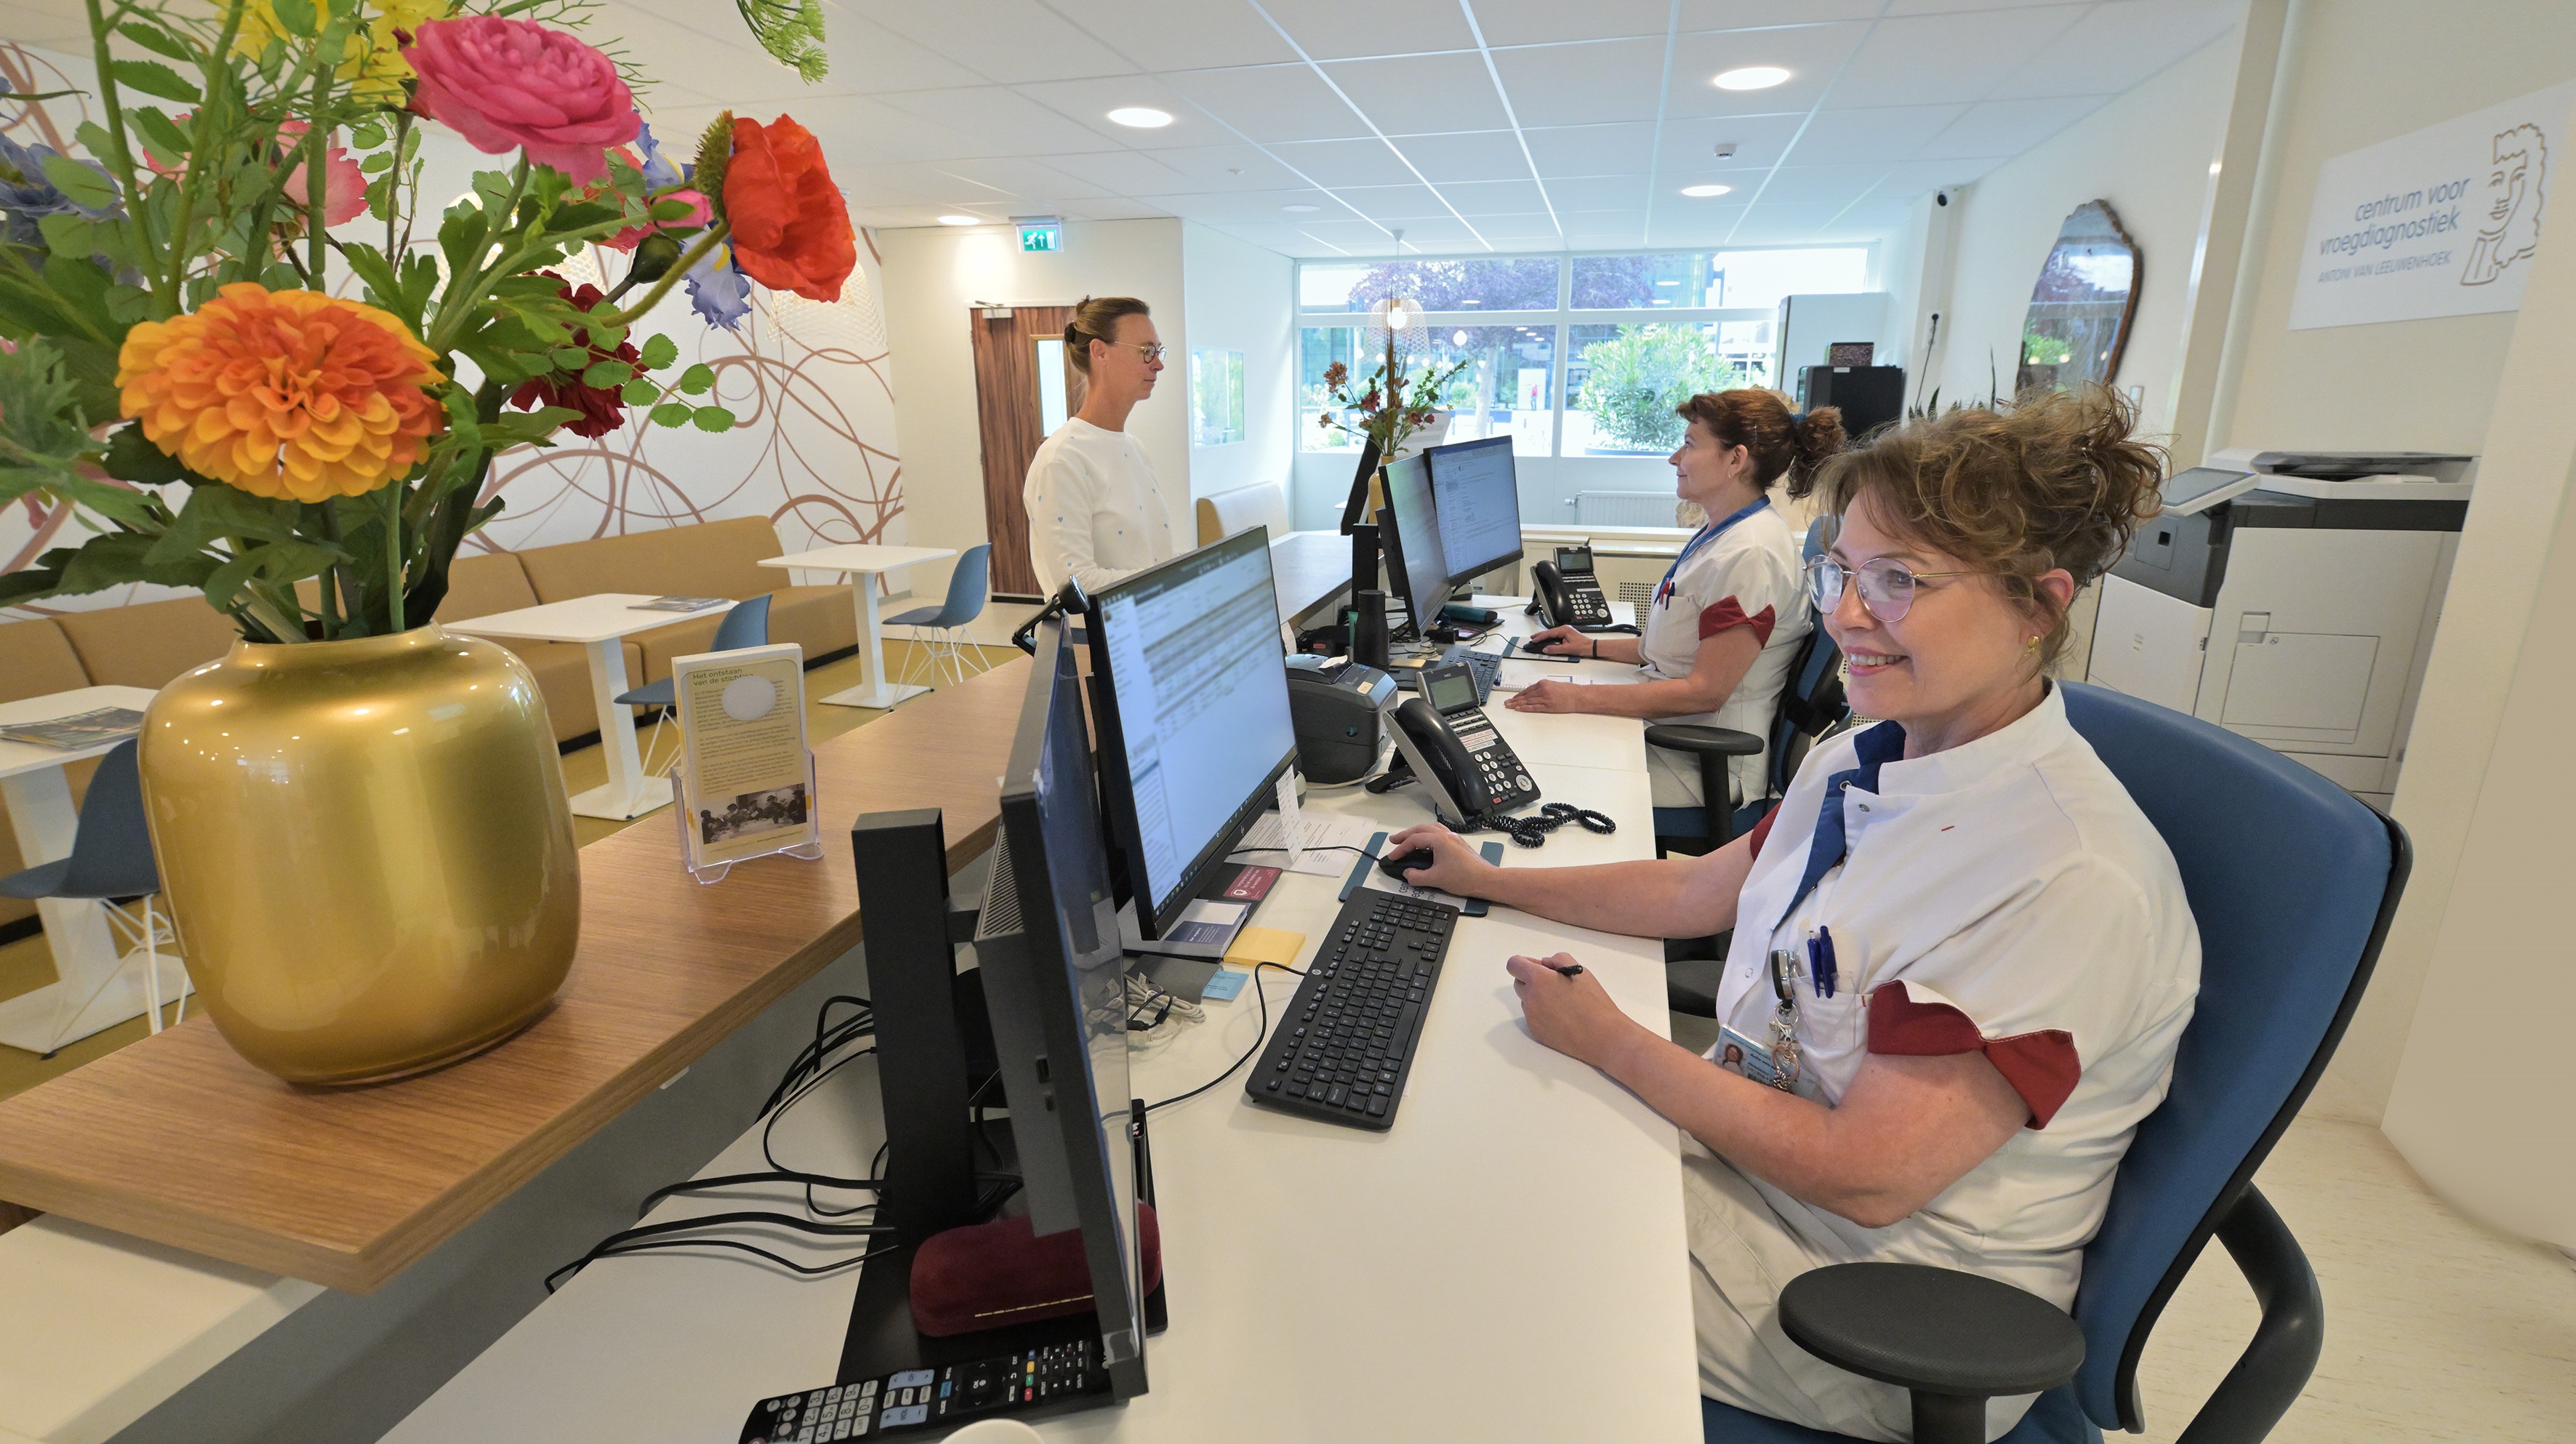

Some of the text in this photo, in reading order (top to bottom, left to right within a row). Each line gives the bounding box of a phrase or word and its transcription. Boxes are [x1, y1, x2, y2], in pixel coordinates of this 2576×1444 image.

[2355, 178, 2471, 222] centrum voor
[2320, 205, 2461, 256] vroegdiagnostiek
[2319, 250, 2453, 284] ANTONI VAN LEEUWENHOEK
[709, 668, 742, 678] ontstaan
[1399, 881, 1410, 894] cen
[973, 1379, 979, 1389] OK
